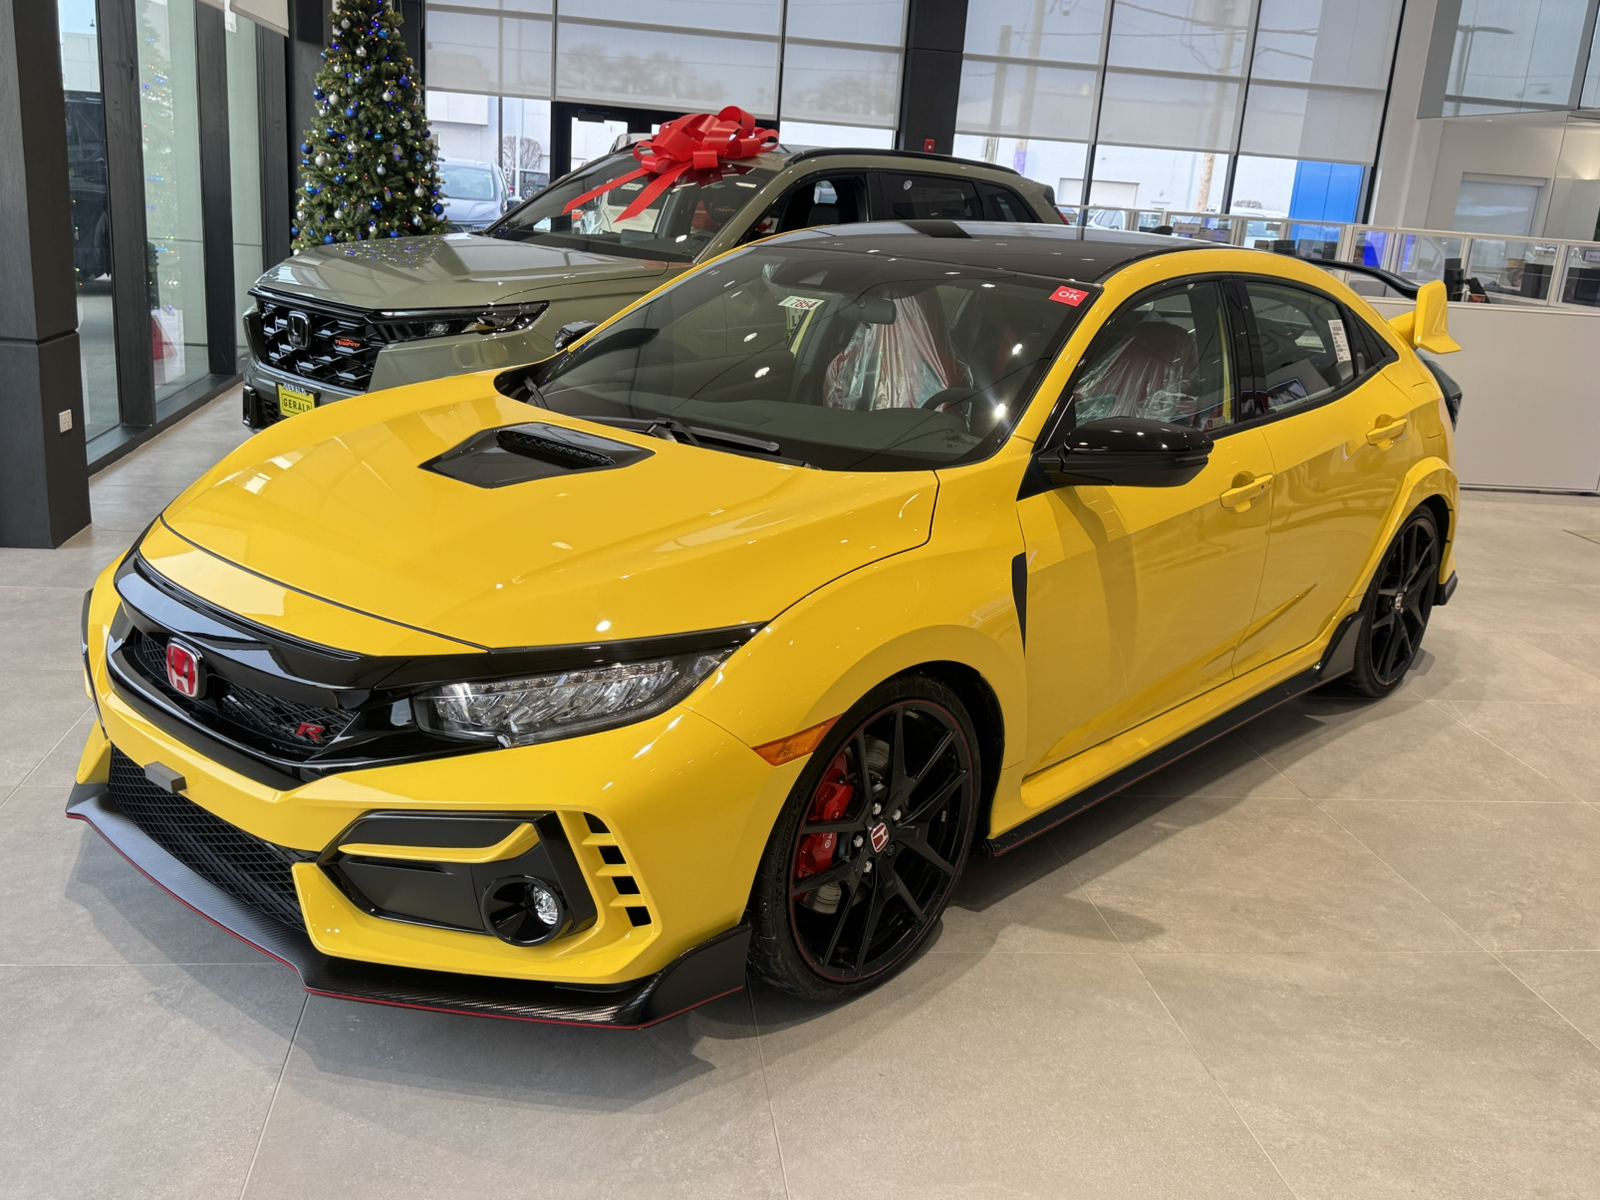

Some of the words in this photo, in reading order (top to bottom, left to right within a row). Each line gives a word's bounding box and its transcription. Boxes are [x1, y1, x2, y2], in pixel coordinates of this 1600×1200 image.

[1058, 290, 1081, 301] OK
[283, 398, 311, 412] GERALD
[296, 722, 324, 742] R
[778, 814, 797, 870] MICHELIN
